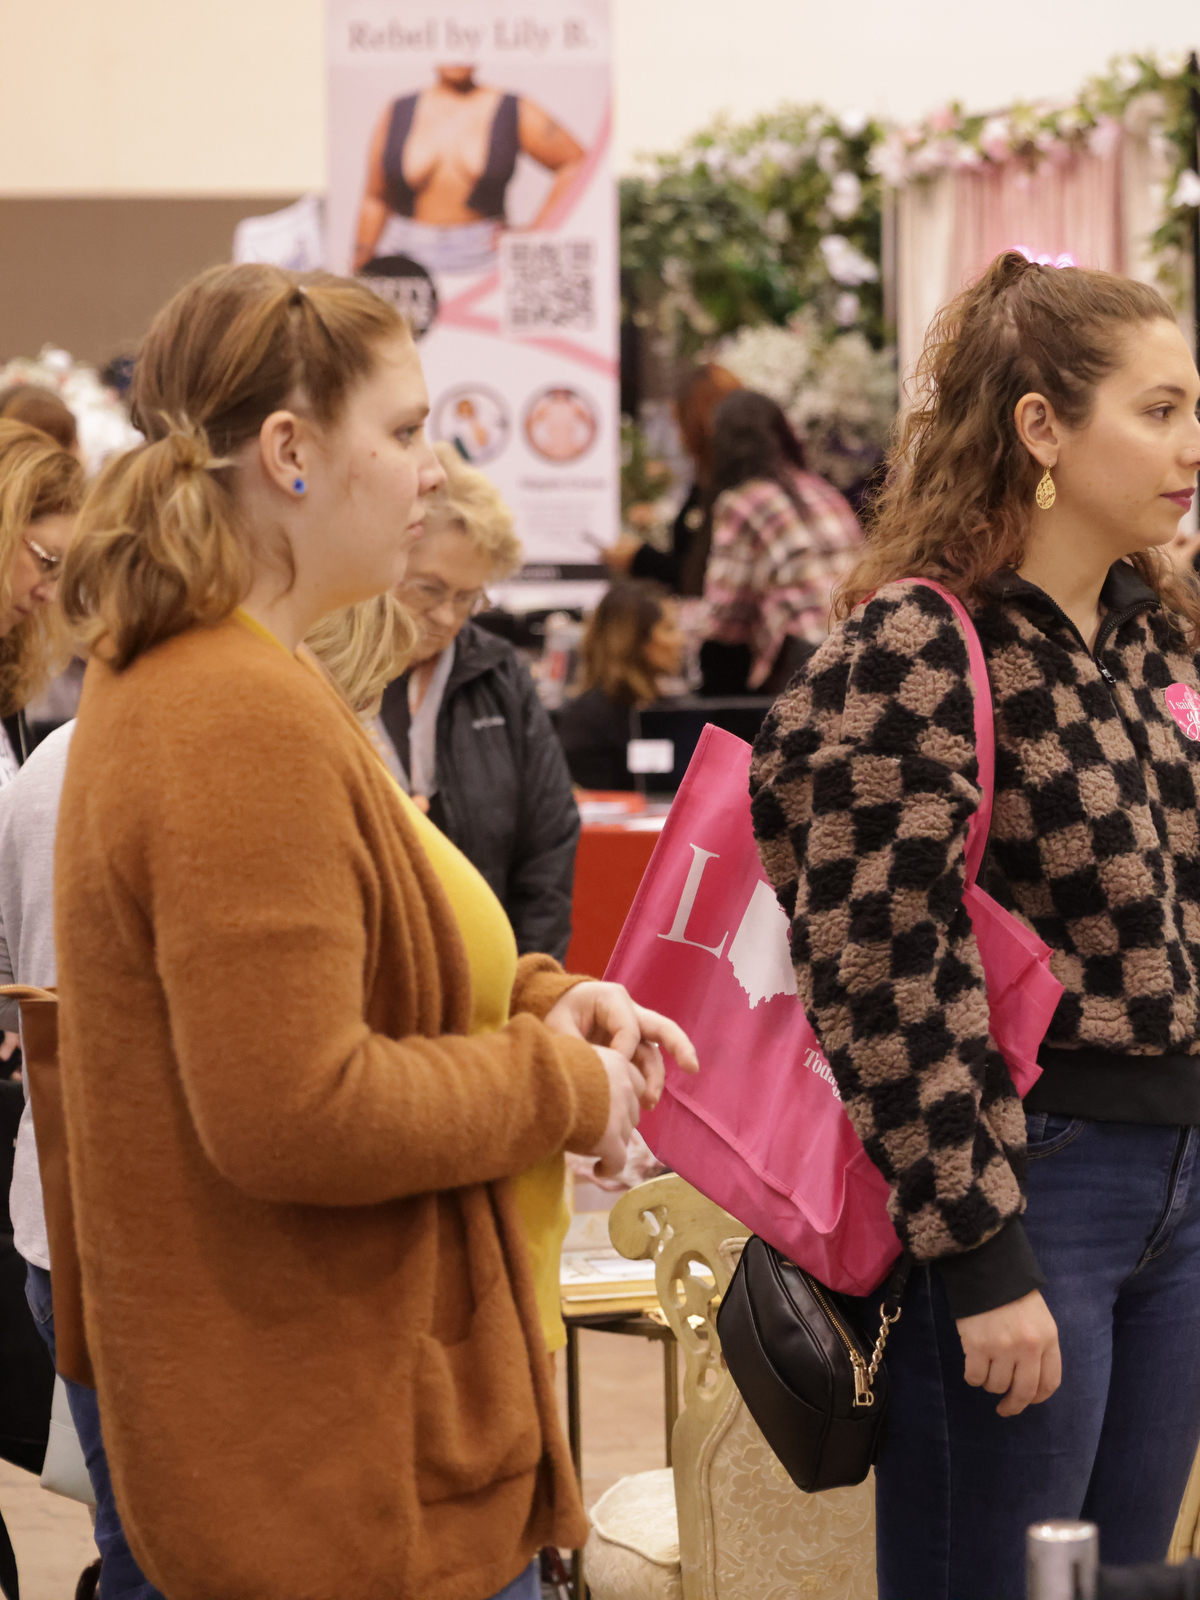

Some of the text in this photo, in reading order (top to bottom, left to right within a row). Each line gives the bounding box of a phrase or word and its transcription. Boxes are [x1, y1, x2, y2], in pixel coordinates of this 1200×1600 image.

[348, 18, 438, 52] Rebel
[445, 18, 486, 56] by
[493, 17, 552, 56] Lily
